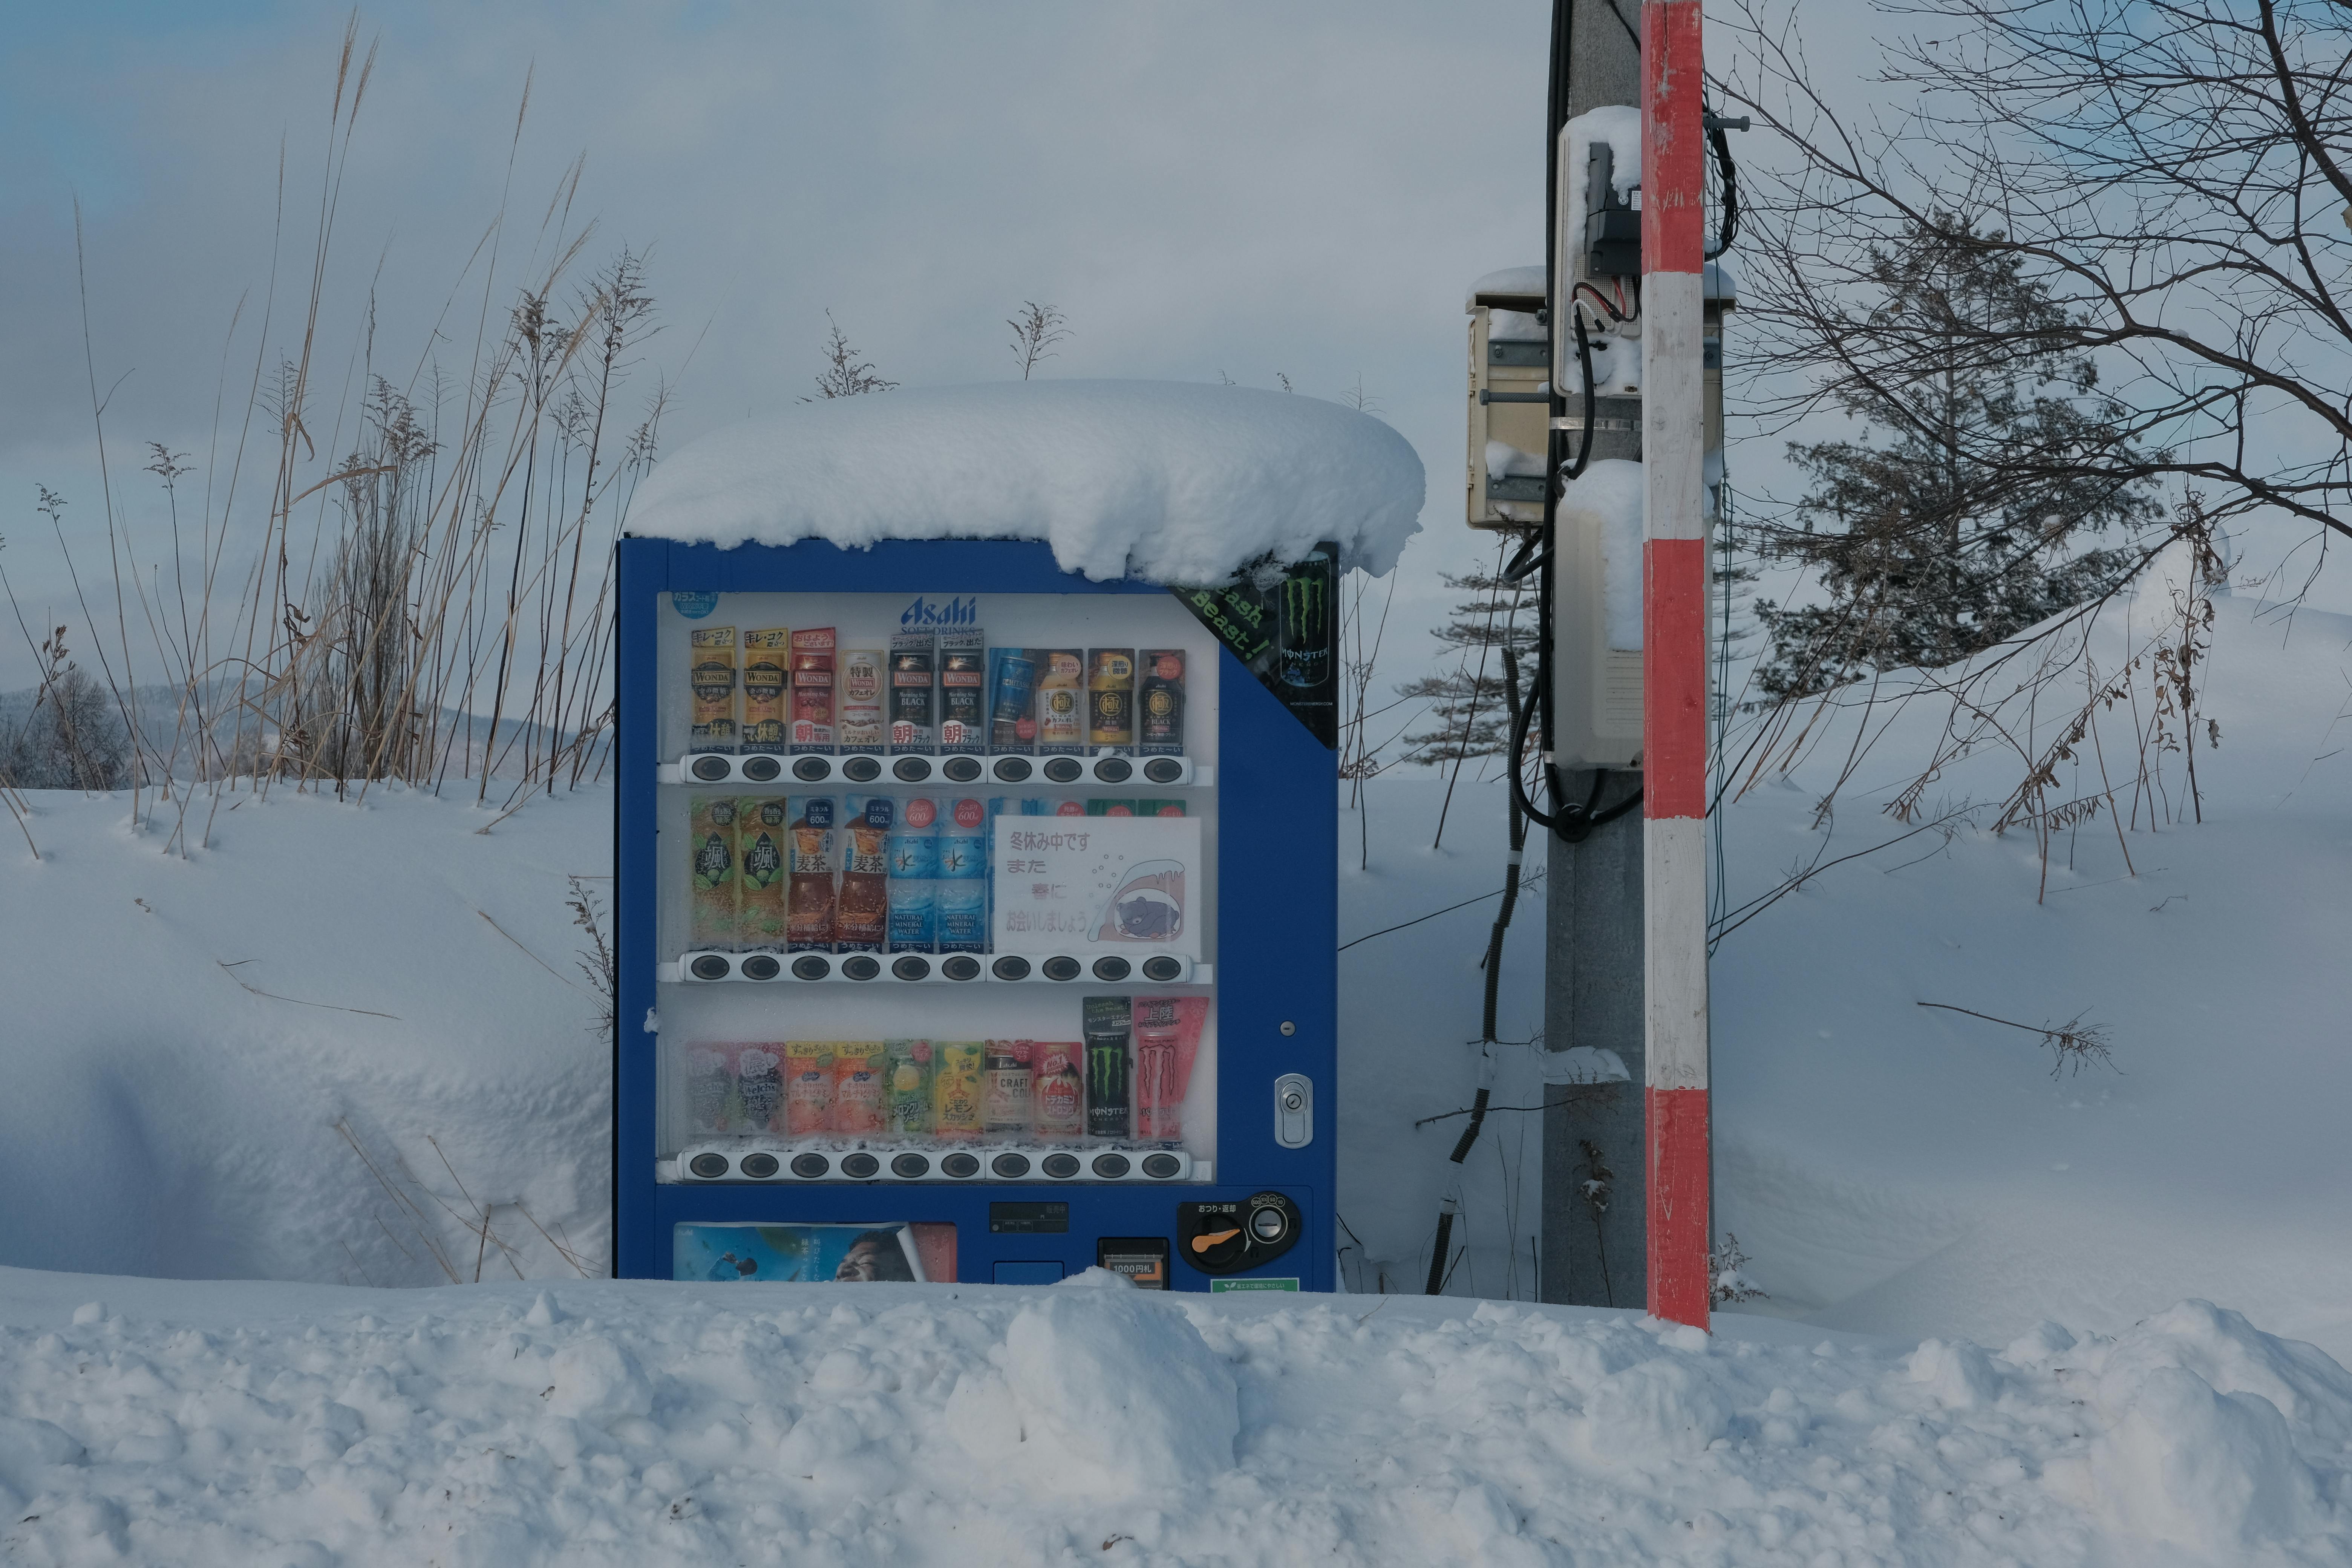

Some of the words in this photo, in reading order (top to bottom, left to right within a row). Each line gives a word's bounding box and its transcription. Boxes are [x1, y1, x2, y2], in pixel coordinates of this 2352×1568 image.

[901, 596, 975, 625] Asahi
[692, 629, 732, 643] キレ・コク
[935, 627, 975, 635] DRINKS
[745, 631, 784, 644] キレ・コク
[794, 633, 829, 642] おはよう
[943, 638, 982, 648] ブラック、出た
[1282, 646, 1328, 662] MONSTER
[694, 672, 729, 682] WONDA
[747, 672, 778, 682] WONDA
[798, 672, 828, 683] WONDA
[850, 666, 874, 678] 特製
[897, 672, 928, 683] WONDA
[946, 672, 977, 683] WONDA
[1053, 694, 1071, 711] 極
[1102, 696, 1119, 712] 極
[1152, 695, 1170, 712] 極
[757, 723, 779, 743] 休憩
[795, 724, 813, 742] 朝
[814, 733, 830, 742] 専用
[893, 725, 912, 744] 朝
[913, 735, 930, 743] ブラック
[944, 725, 962, 744] 朝
[962, 735, 980, 744] ブラック
[1011, 831, 1090, 851] 冬休み中です
[796, 854, 827, 872] 麦茶
[854, 855, 884, 873] 麦茶
[1007, 859, 1046, 873] また
[1032, 882, 1067, 900] 春に
[1006, 910, 1086, 933] お会いしましょう
[1087, 1014, 1130, 1023] モンスターエナジー
[1144, 1005, 1173, 1021] 上陸
[842, 1043, 864, 1055] すっきり
[1047, 1055, 1063, 1068] No.1
[1000, 1078, 1028, 1087] CRAFT
[1045, 1095, 1074, 1104] ドデカミン
[945, 1104, 973, 1113] レモン
[1047, 1106, 1073, 1115] ストロング
[1090, 1107, 1127, 1116] MONSTER
[942, 1113, 975, 1121] スカッシュ
[1114, 1265, 1152, 1273] 1000円札
